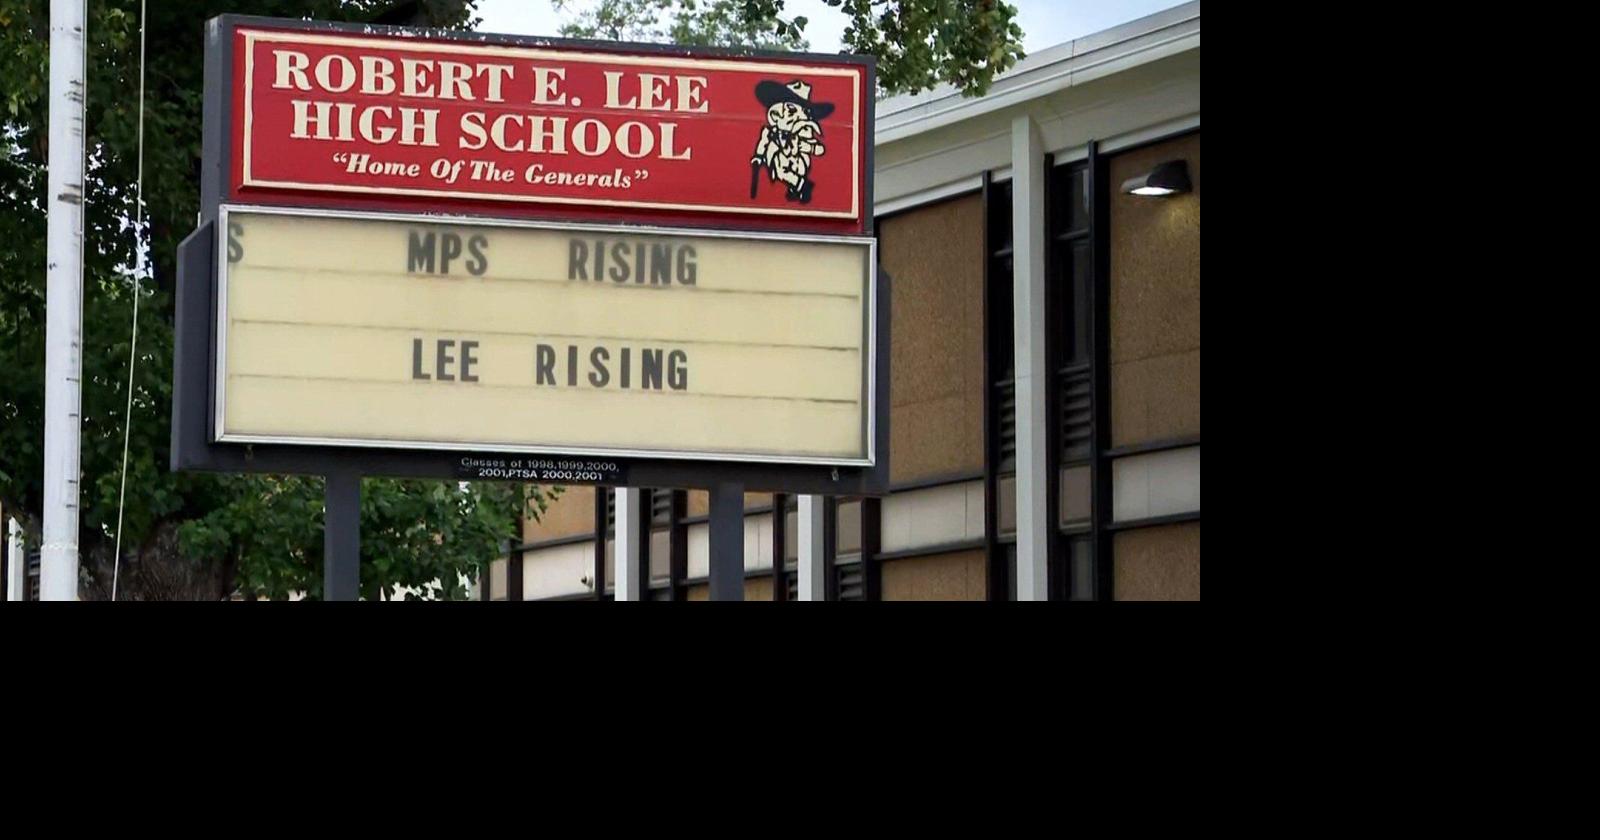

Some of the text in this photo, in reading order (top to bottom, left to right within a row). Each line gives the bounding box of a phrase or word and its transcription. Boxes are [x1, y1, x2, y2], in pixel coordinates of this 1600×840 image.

[273, 50, 710, 114] ROBERT E. LEE
[290, 100, 692, 162] HIGH SCHOOL
[333, 152, 649, 190] “Home Of The Generals”
[408, 230, 488, 277] MPS
[568, 238, 697, 286] RISING
[412, 338, 688, 391] LEE RISING
[461, 457, 506, 468] Classes
[511, 459, 522, 468] of
[478, 468, 538, 479] 2001,PTSA
